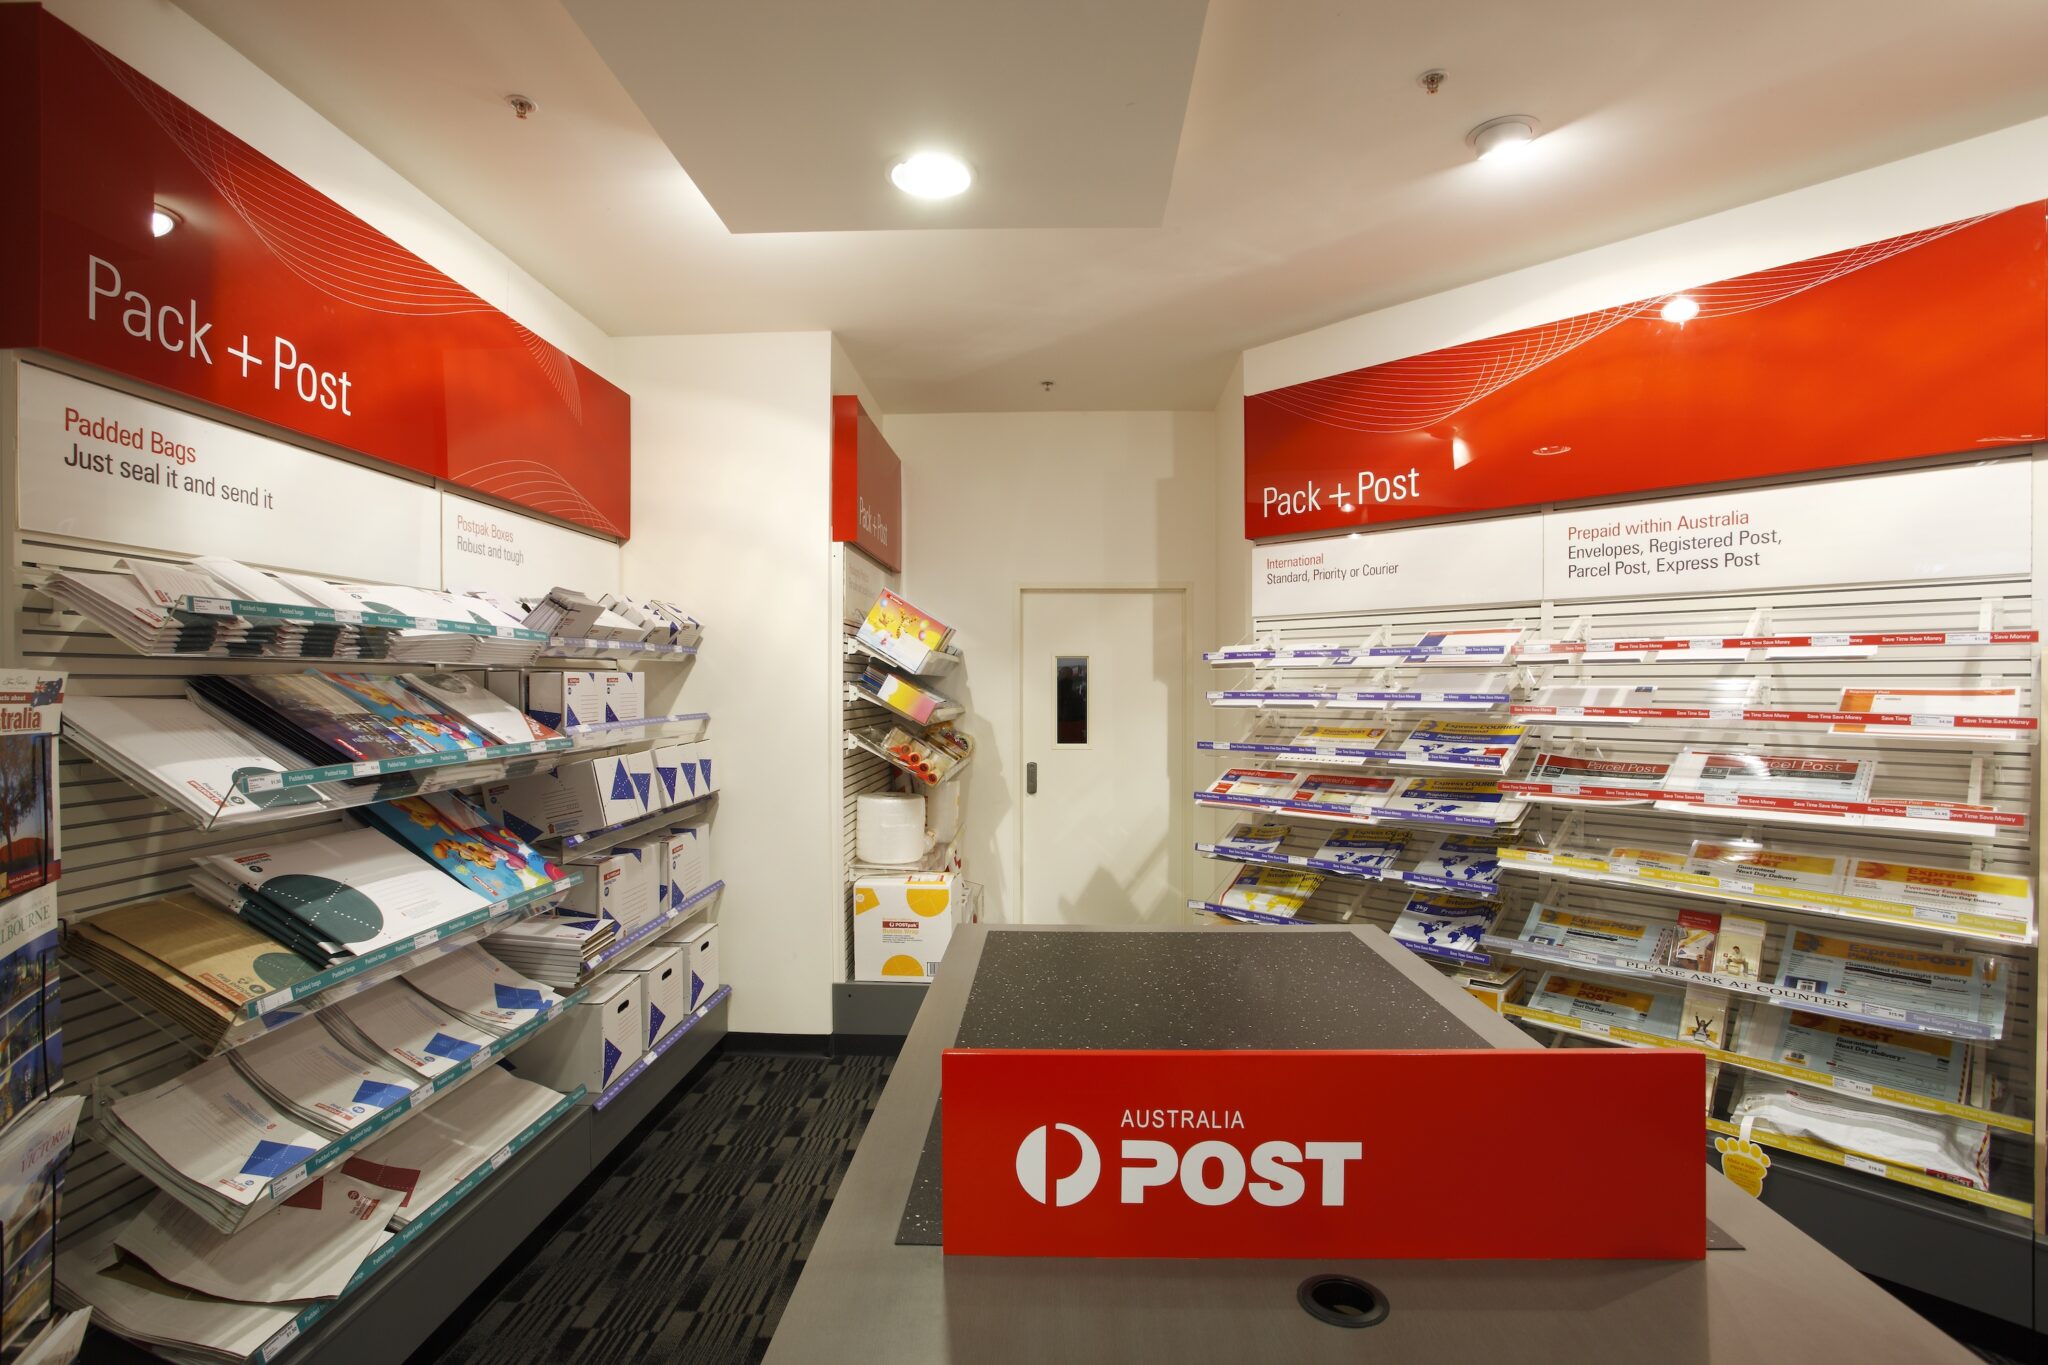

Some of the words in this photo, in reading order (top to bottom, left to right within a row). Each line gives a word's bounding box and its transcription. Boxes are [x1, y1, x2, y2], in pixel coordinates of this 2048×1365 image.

[88, 254, 213, 365] Pack
[274, 335, 352, 417] Post
[64, 406, 144, 451] Padded
[150, 430, 197, 466] Bags
[64, 442, 114, 475] Just
[119, 460, 160, 486] seal
[166, 465, 178, 490] it
[183, 476, 216, 498] and
[220, 486, 260, 508] send
[263, 487, 274, 510] it
[1263, 480, 1321, 518] Pack
[1358, 467, 1420, 505] Post
[457, 514, 489, 538] Postpak
[491, 523, 514, 543] Boxes
[859, 495, 873, 534] Pack
[877, 511, 888, 548] Post
[1568, 522, 1621, 541] Prepaid
[1625, 516, 1672, 536] within
[1676, 509, 1750, 531] Australia
[457, 535, 486, 557] Robust
[487, 545, 502, 560] and
[503, 548, 524, 566] tough
[1568, 541, 1645, 560] Envelopes,
[1649, 531, 1734, 556] Registered
[1738, 528, 1783, 547] Post,
[1266, 552, 1325, 570] International
[1568, 561, 1610, 579] Parcel
[1614, 559, 1651, 576] Post,
[1656, 554, 1719, 575] Express
[1723, 551, 1761, 568] Post
[1266, 569, 1310, 586] Standard,
[1313, 566, 1348, 582] Priority
[1349, 566, 1360, 578] or
[1362, 562, 1399, 578] Courier
[1586, 760, 1627, 772] Parcel
[1627, 763, 1657, 774] Post
[1799, 760, 1843, 772] Post
[1994, 815, 2016, 823] Money
[1735, 868, 1750, 876] Next
[1751, 870, 1767, 879] Day
[1768, 873, 1799, 882] Delivery
[1906, 876, 1953, 887] POST
[1907, 867, 1975, 882] Express
[1904, 884, 1943, 894] Two-way
[1943, 889, 1978, 898] Envelope
[1414, 903, 1429, 912] 3kg
[1848, 943, 1914, 961] Express
[1917, 951, 1970, 968] POST
[1845, 961, 1890, 974] Guaranteed
[1890, 966, 1932, 980] Overnight
[1932, 973, 1968, 985] Delivery
[295, 984, 311, 994] Padded
[310, 980, 321, 989] bags
[1625, 961, 1686, 978] PLEASE
[1690, 972, 1723, 986] ASK
[1729, 979, 1752, 991] AT
[1756, 984, 1849, 1009] COUNTER
[1577, 989, 1613, 1003] POST
[1836, 1036, 1878, 1051] Guaranteed
[1838, 1024, 1893, 1043] POST
[1835, 1042, 1852, 1052] Next
[1852, 1044, 1870, 1056] Day
[1120, 1109, 1245, 1130] AUSTRALIA
[315, 1151, 330, 1165] Padded
[1120, 1139, 1363, 1208] POST
